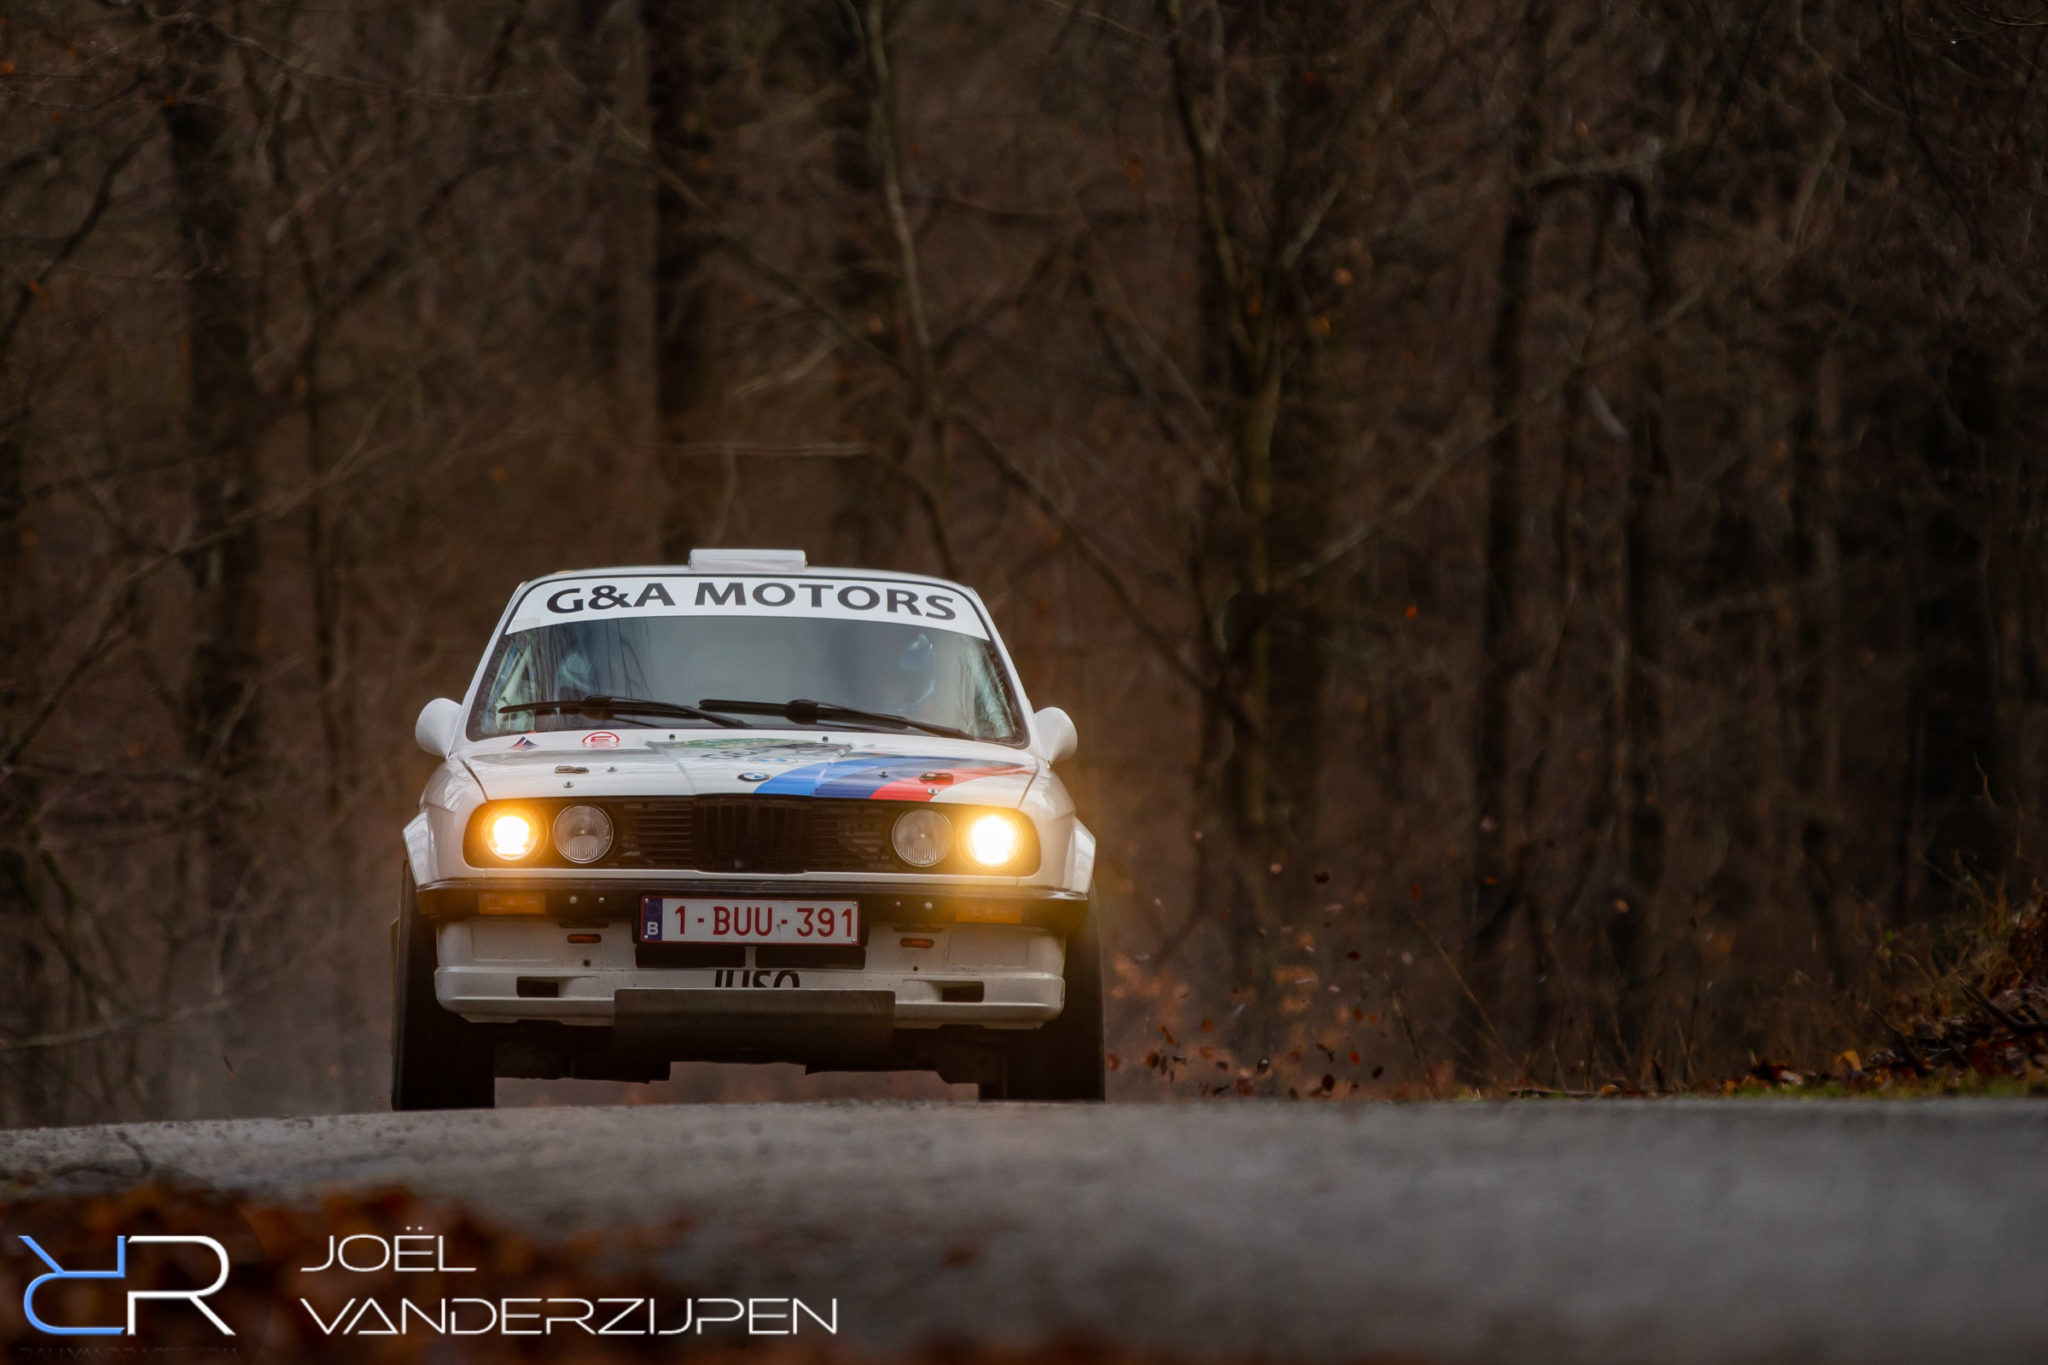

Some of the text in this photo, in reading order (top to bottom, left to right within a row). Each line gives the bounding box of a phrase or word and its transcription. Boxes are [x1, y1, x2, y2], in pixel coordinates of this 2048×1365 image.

[546, 581, 957, 621] G&A MOTORS
[646, 921, 659, 936] B
